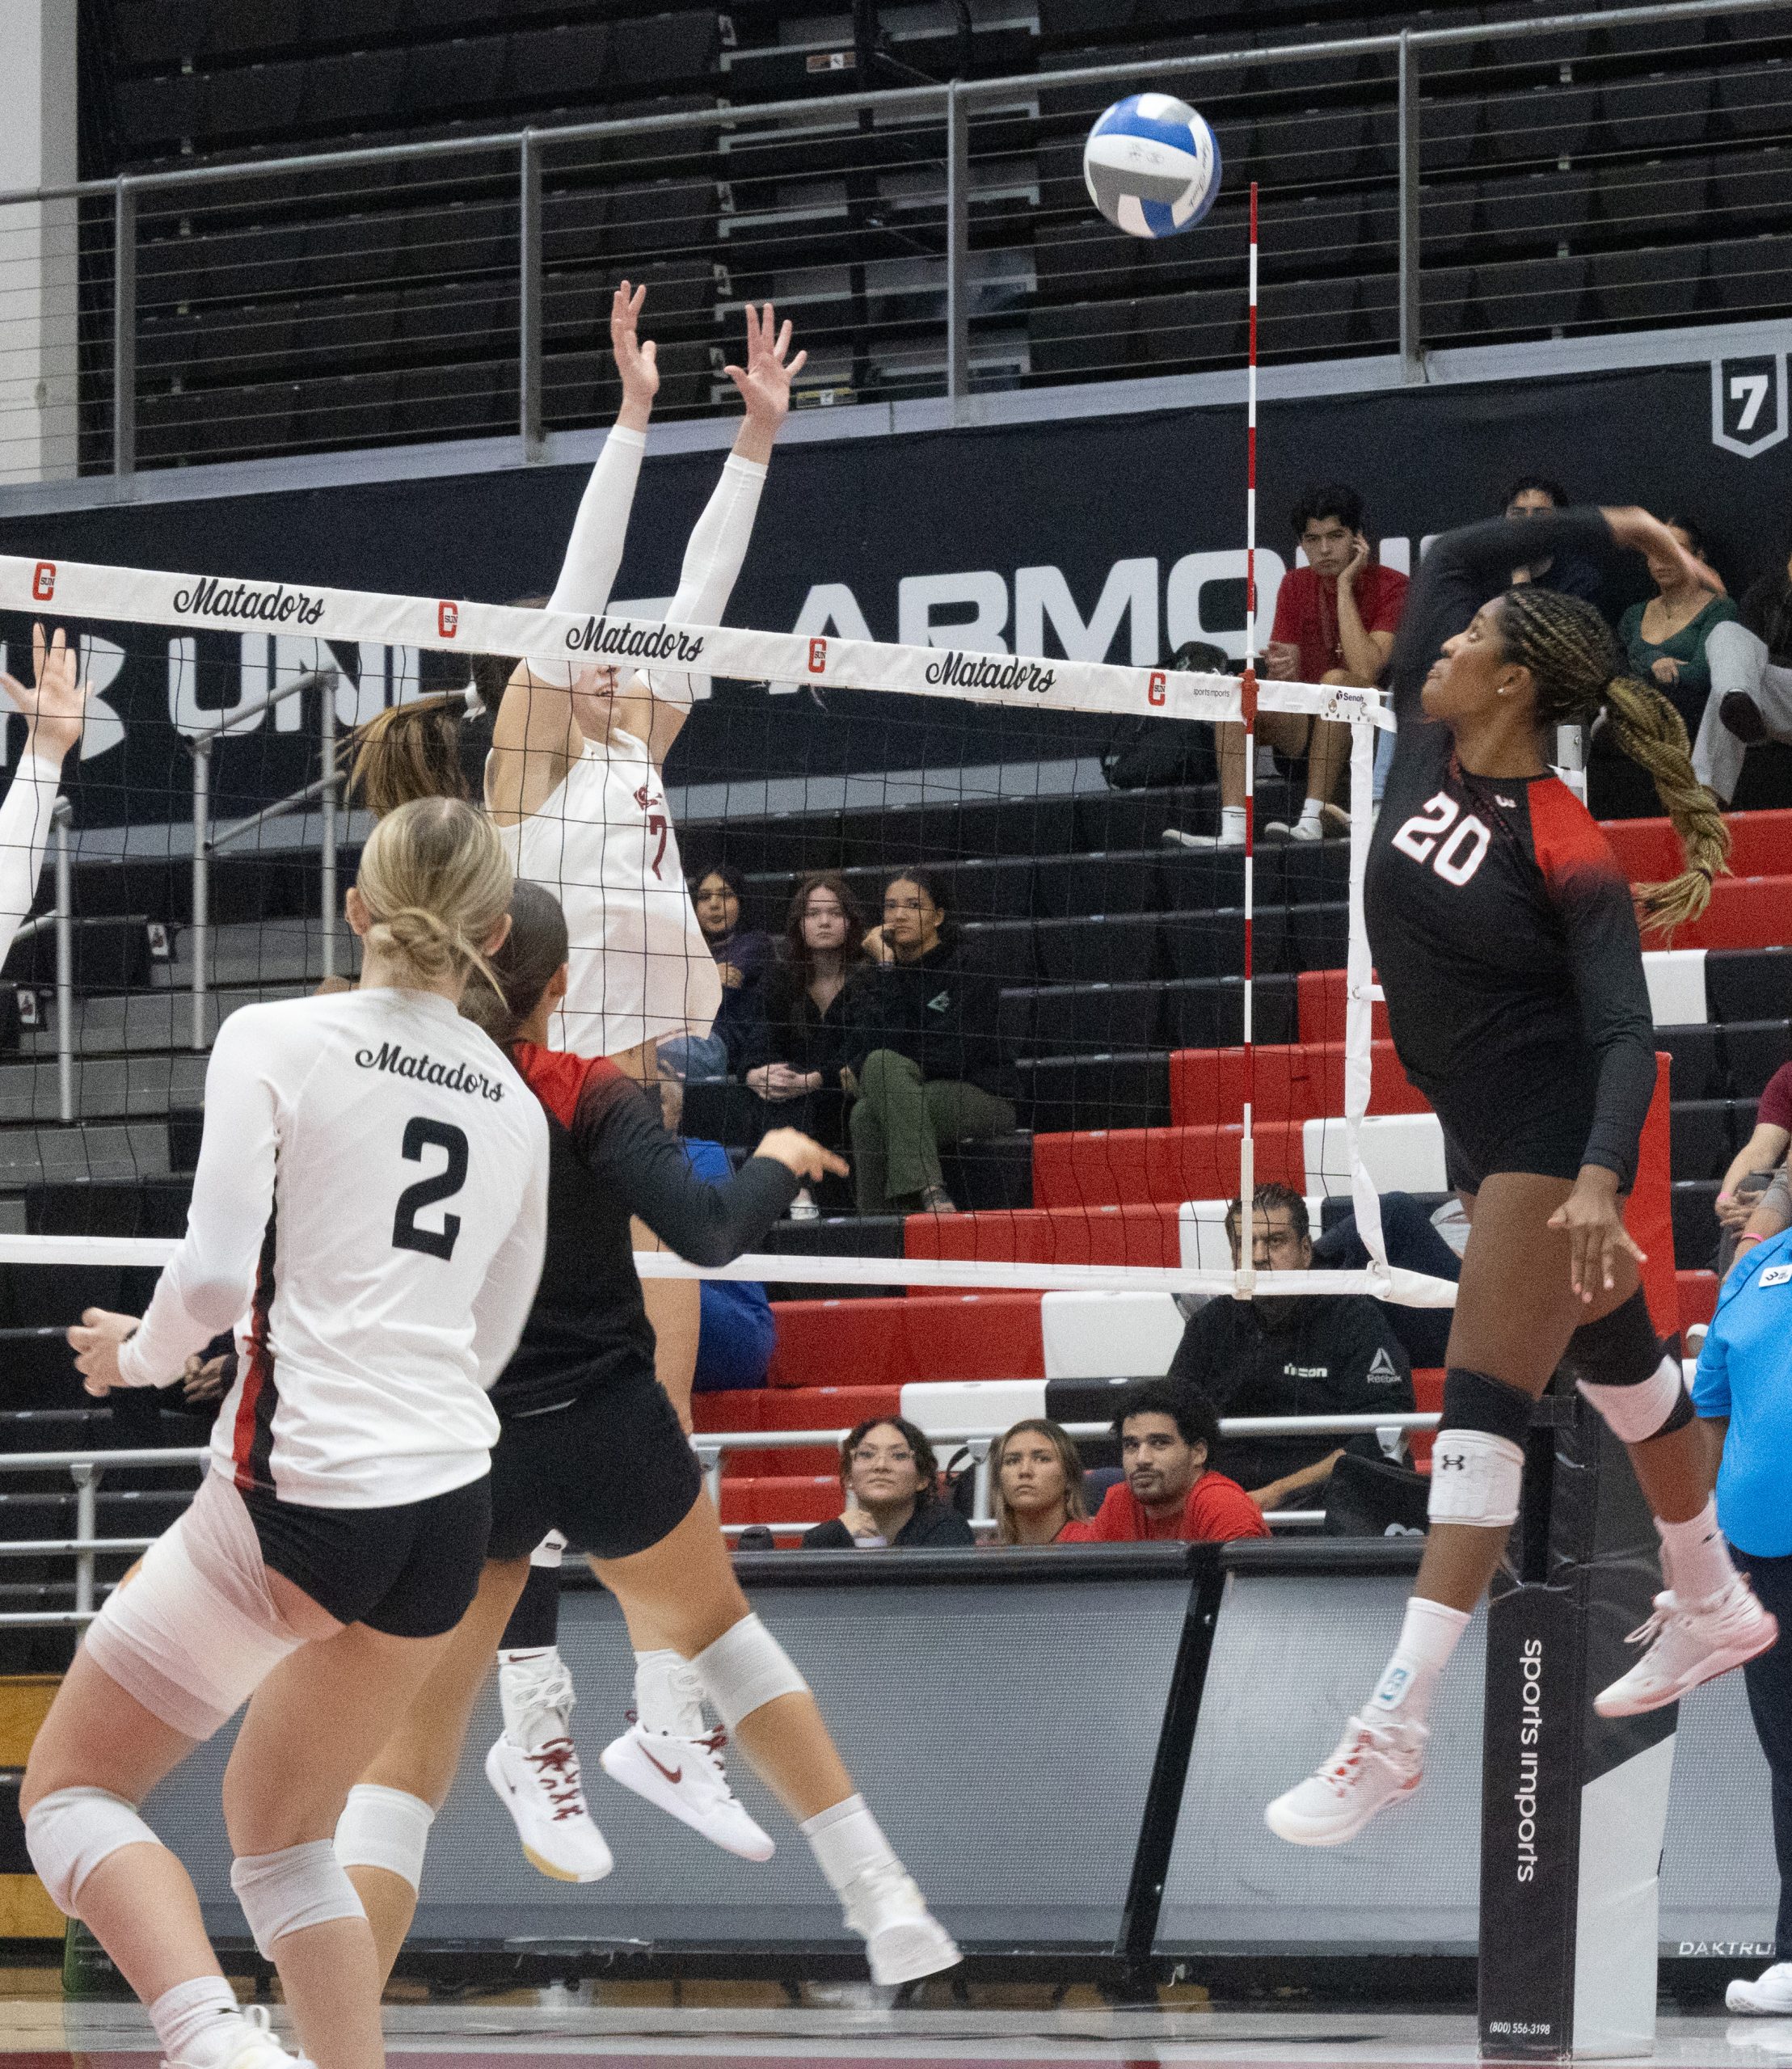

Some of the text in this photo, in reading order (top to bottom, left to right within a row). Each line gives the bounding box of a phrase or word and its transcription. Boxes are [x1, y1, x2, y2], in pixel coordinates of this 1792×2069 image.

[1731, 374, 1769, 430] 7
[173, 577, 325, 625] Matadors
[565, 616, 705, 662] Matadors
[926, 651, 1056, 693] Matadors
[1343, 692, 1364, 702] Senoh
[648, 815, 667, 881] 7
[1391, 790, 1492, 887] 20
[355, 1041, 506, 1102] Matadors
[392, 1116, 470, 1262] 2
[1520, 1638, 1543, 1745] sports
[1678, 1941, 1777, 1956] DAKTRU
[1490, 2021, 1550, 2035] (800) 556-3198
